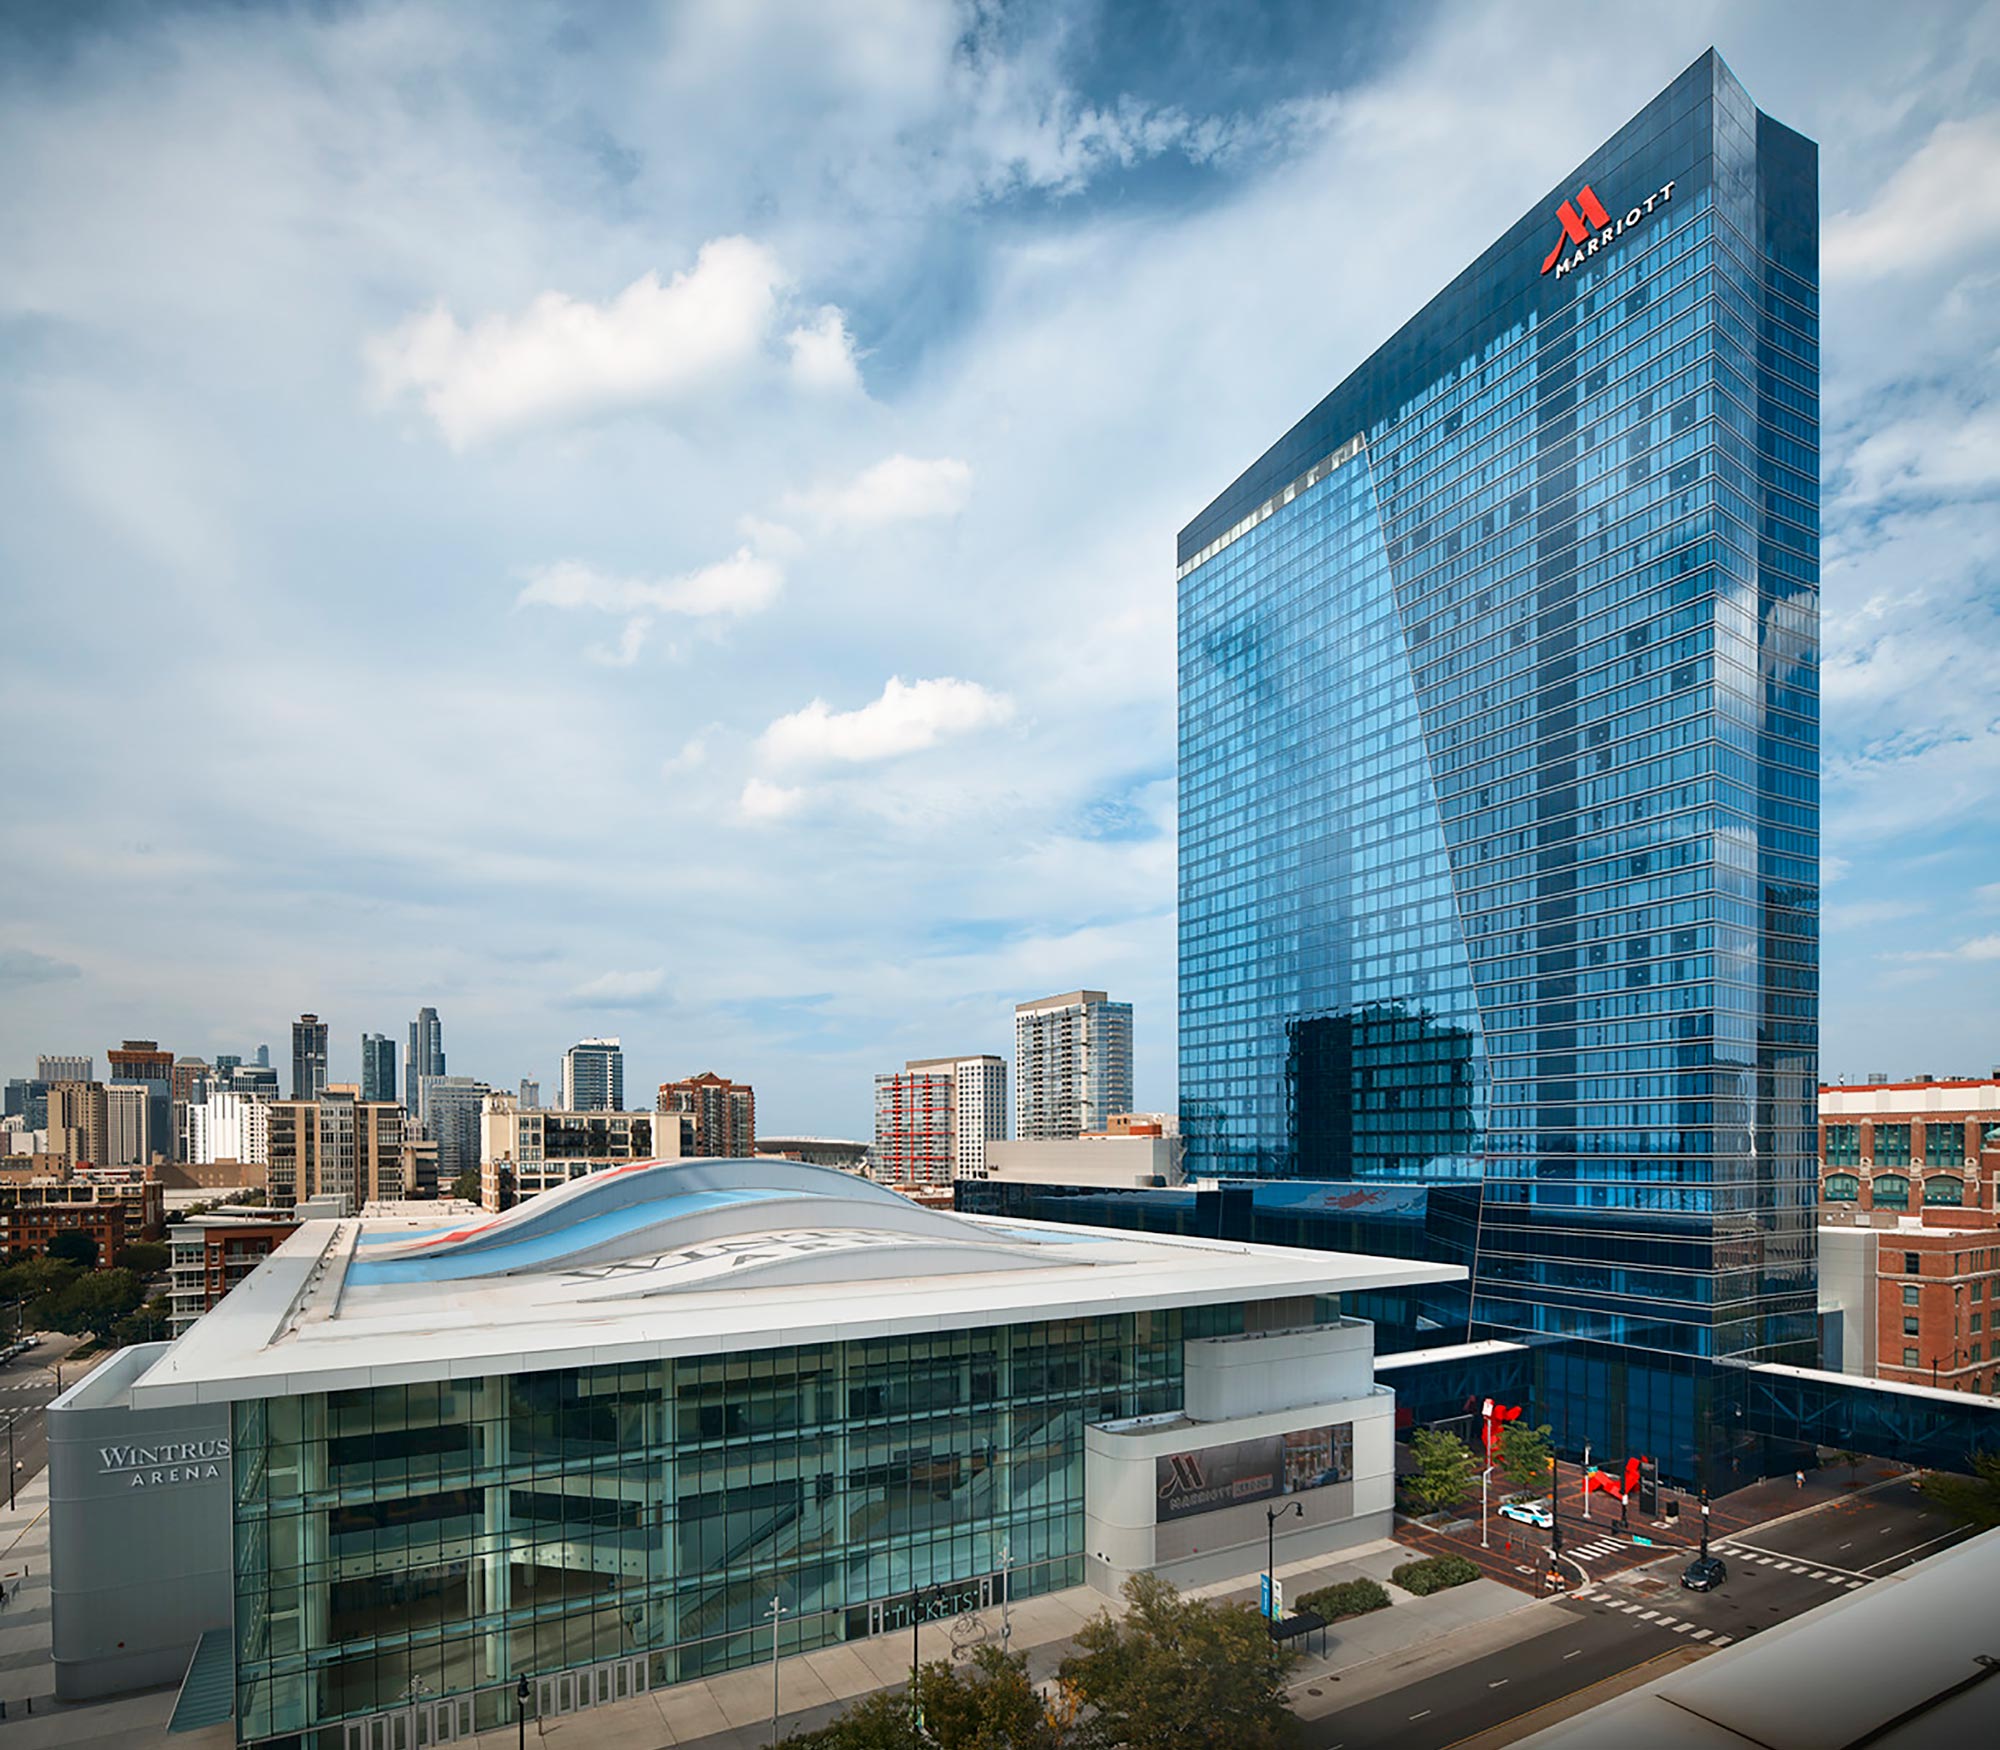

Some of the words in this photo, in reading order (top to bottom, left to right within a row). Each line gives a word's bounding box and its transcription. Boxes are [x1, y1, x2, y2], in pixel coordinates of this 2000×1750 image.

[1555, 180, 1676, 280] MARRIOTT
[131, 1464, 220, 1487] ARENA
[891, 1591, 974, 1630] TICKETS
